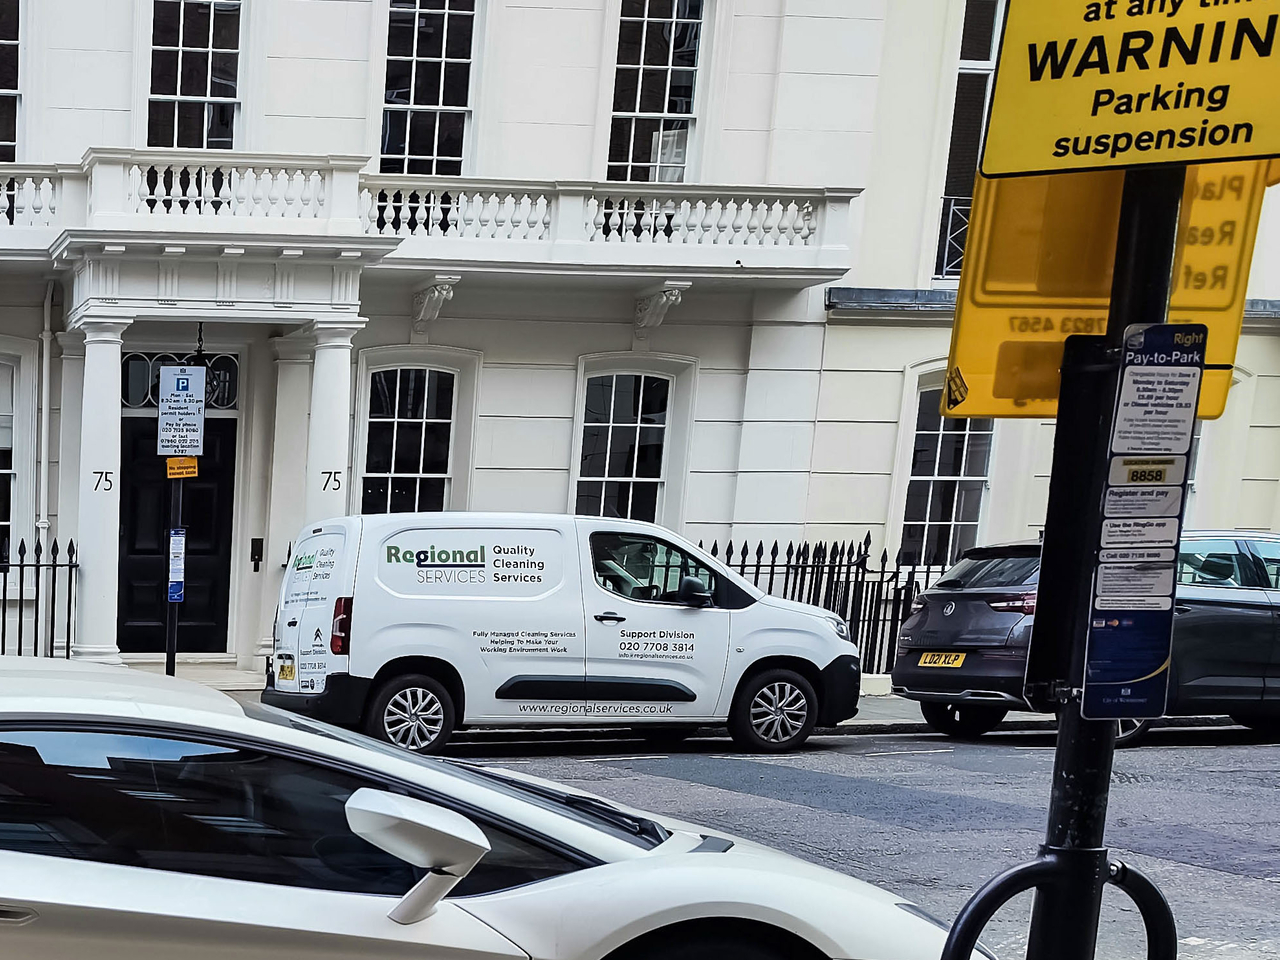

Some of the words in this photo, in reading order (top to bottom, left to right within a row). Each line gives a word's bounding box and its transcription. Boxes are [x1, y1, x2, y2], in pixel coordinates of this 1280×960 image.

[1083, 0, 1117, 22] at
[1027, 14, 1279, 82] WARNIN
[1091, 81, 1230, 117] Parking
[1052, 118, 1253, 158] suspension
[1174, 332, 1204, 347] Right
[1125, 351, 1201, 365] Pay-to-Park
[92, 471, 114, 492] 75
[320, 471, 342, 492] 75
[1131, 470, 1162, 482] 8858
[1155, 490, 1169, 498] pay
[386, 544, 486, 568] Regional
[493, 545, 535, 557] Quality
[493, 558, 545, 570] Cleaning
[417, 570, 486, 584] SERVICES
[493, 572, 542, 582] Services
[620, 630, 656, 639] Support
[659, 630, 695, 639] Division
[619, 642, 640, 651] 020
[643, 642, 669, 651] 7708
[672, 643, 694, 652] 3814
[518, 702, 673, 715] www.regionalservices.co.uk
